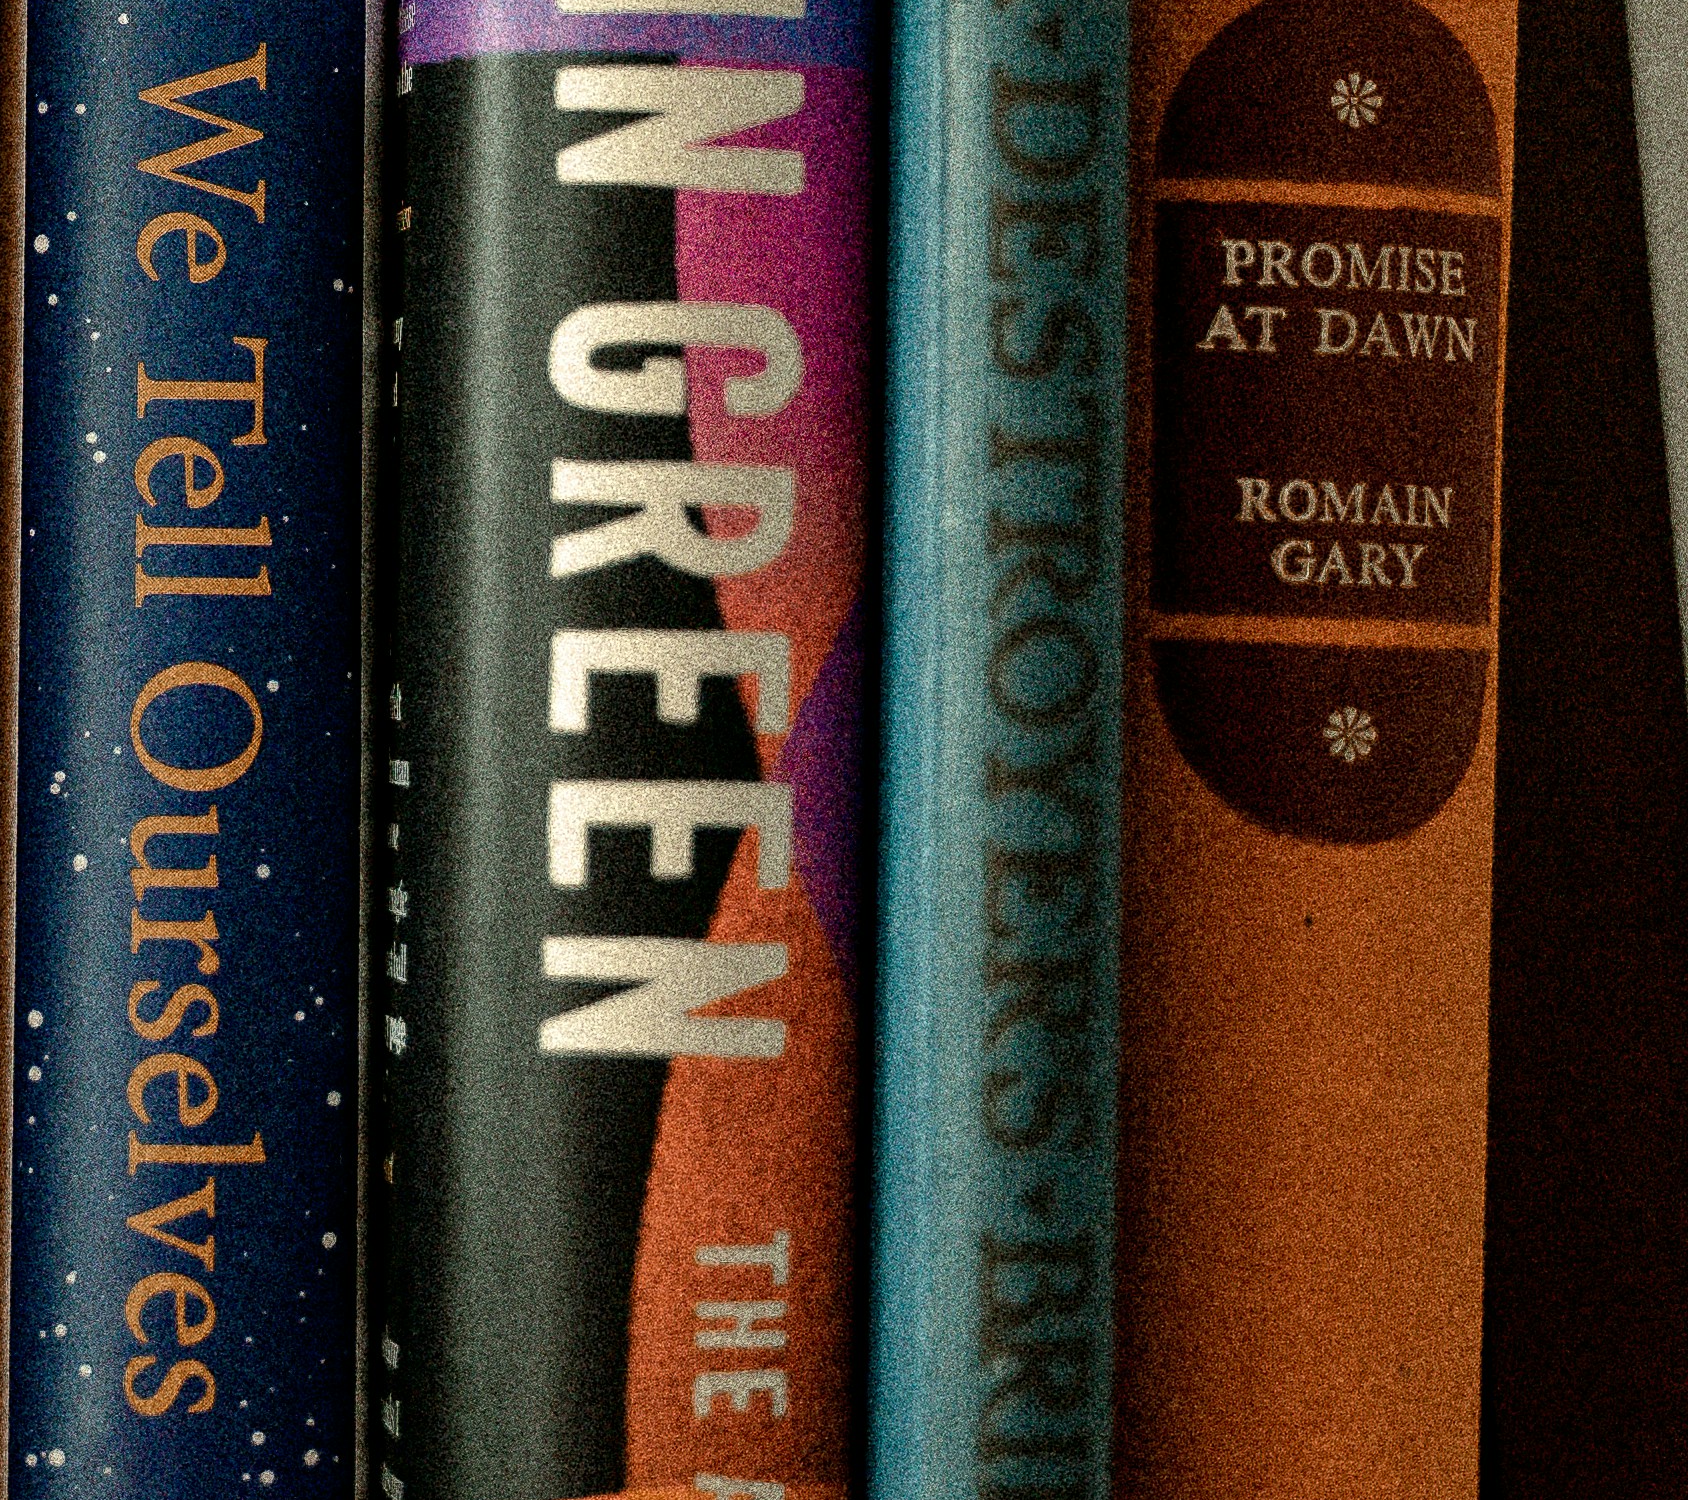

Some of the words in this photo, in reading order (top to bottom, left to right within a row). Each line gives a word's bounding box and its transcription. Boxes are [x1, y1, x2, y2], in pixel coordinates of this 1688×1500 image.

[135, 42, 269, 287] We
[1198, 304, 1286, 354] AT
[1315, 306, 1479, 365] DAWN
[1222, 238, 1468, 298] PROMISE
[133, 335, 271, 606] Tell
[1237, 476, 1454, 531] ROMAIN
[1271, 537, 1426, 590] GARY
[538, 299, 807, 1060] GREEN
[123, 659, 267, 1420] Ourselves
[689, 1228, 793, 1422] THE
